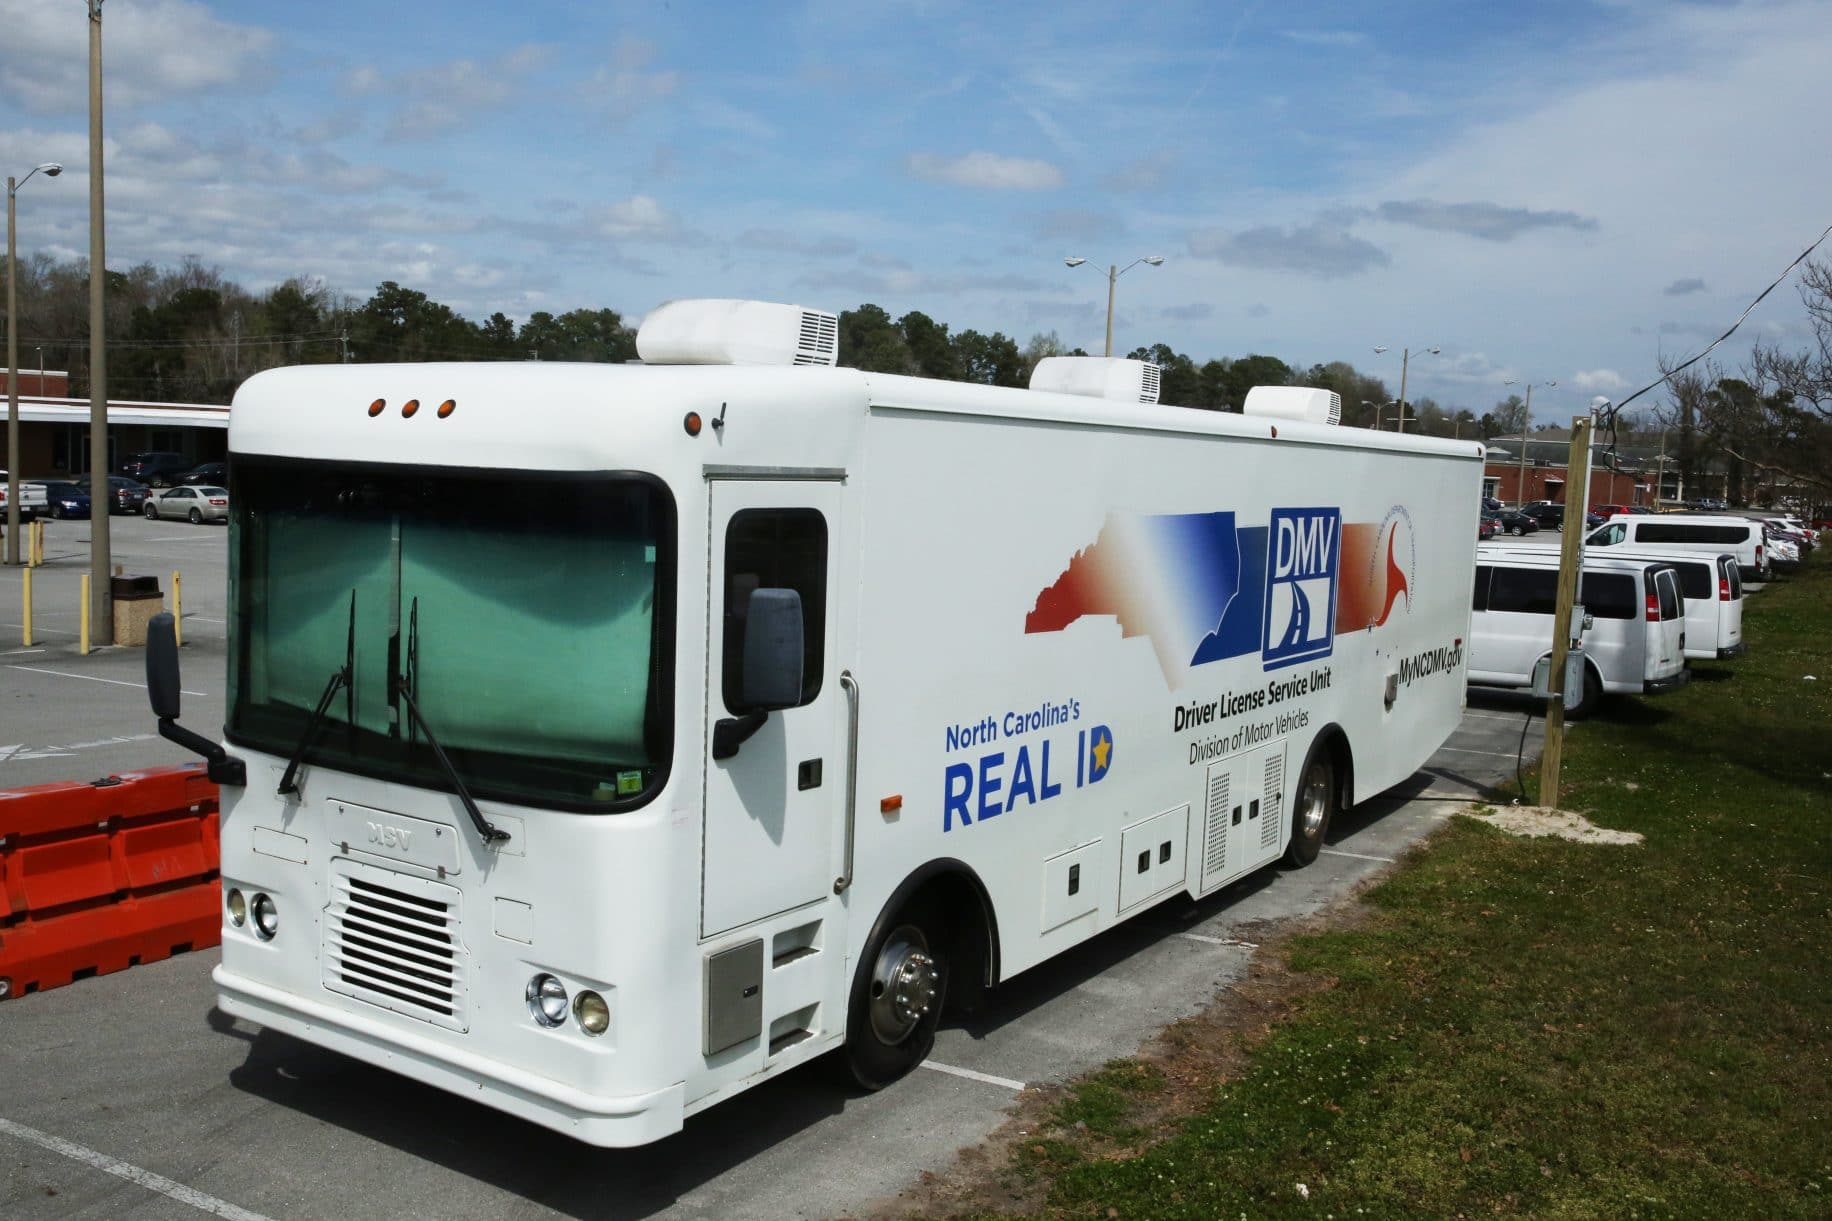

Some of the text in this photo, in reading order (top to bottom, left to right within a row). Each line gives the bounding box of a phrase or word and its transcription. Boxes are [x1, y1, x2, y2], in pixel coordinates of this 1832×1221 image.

[1274, 517, 1336, 579] DMV
[1399, 646, 1462, 687] MyNCDMV.gov
[946, 697, 1080, 753] North Carolina's
[1174, 665, 1331, 732] Driver License Service Unit
[1189, 707, 1309, 765] Division of Motor Vehicles
[943, 724, 1113, 833] REAL ID
[367, 821, 411, 851] MSV
